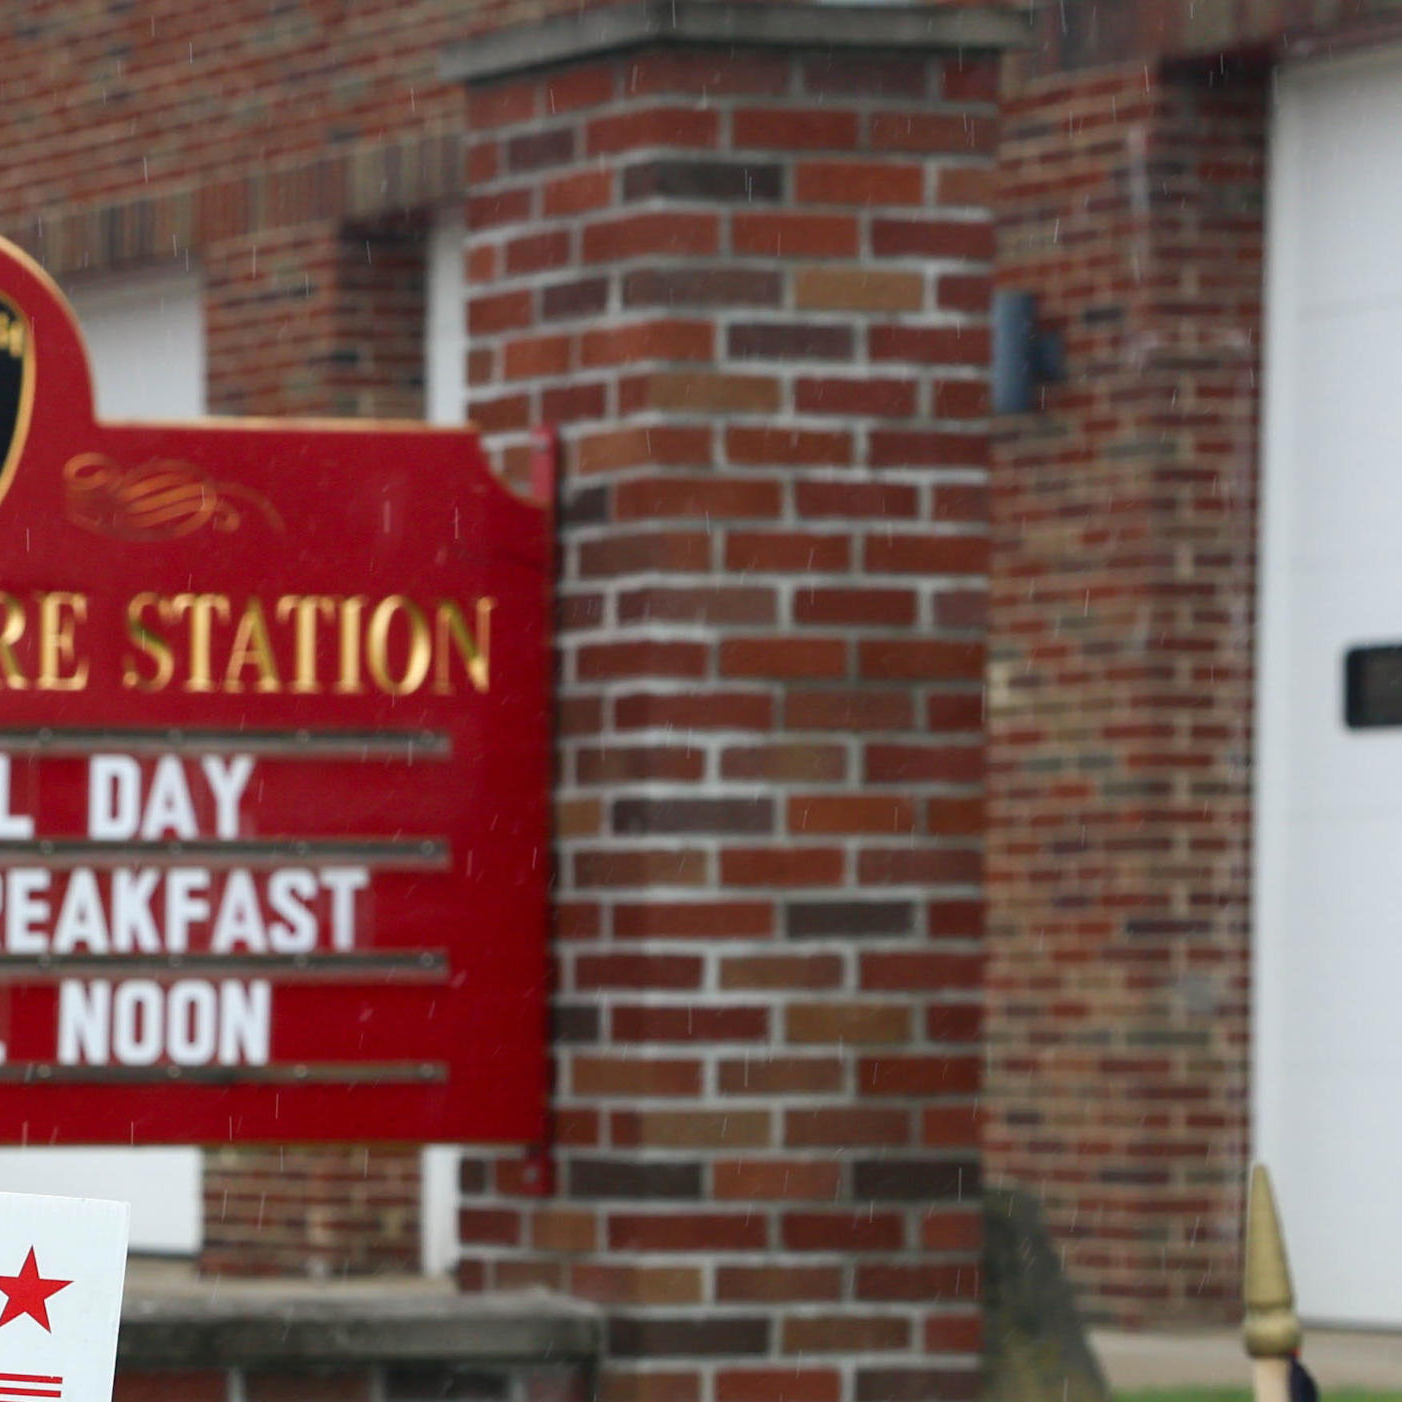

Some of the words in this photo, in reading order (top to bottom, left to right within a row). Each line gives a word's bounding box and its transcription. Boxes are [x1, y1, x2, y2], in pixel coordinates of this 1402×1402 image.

[123, 593, 494, 695] STATION
[88, 754, 256, 841] DAY
[57, 979, 271, 1067] NOON
